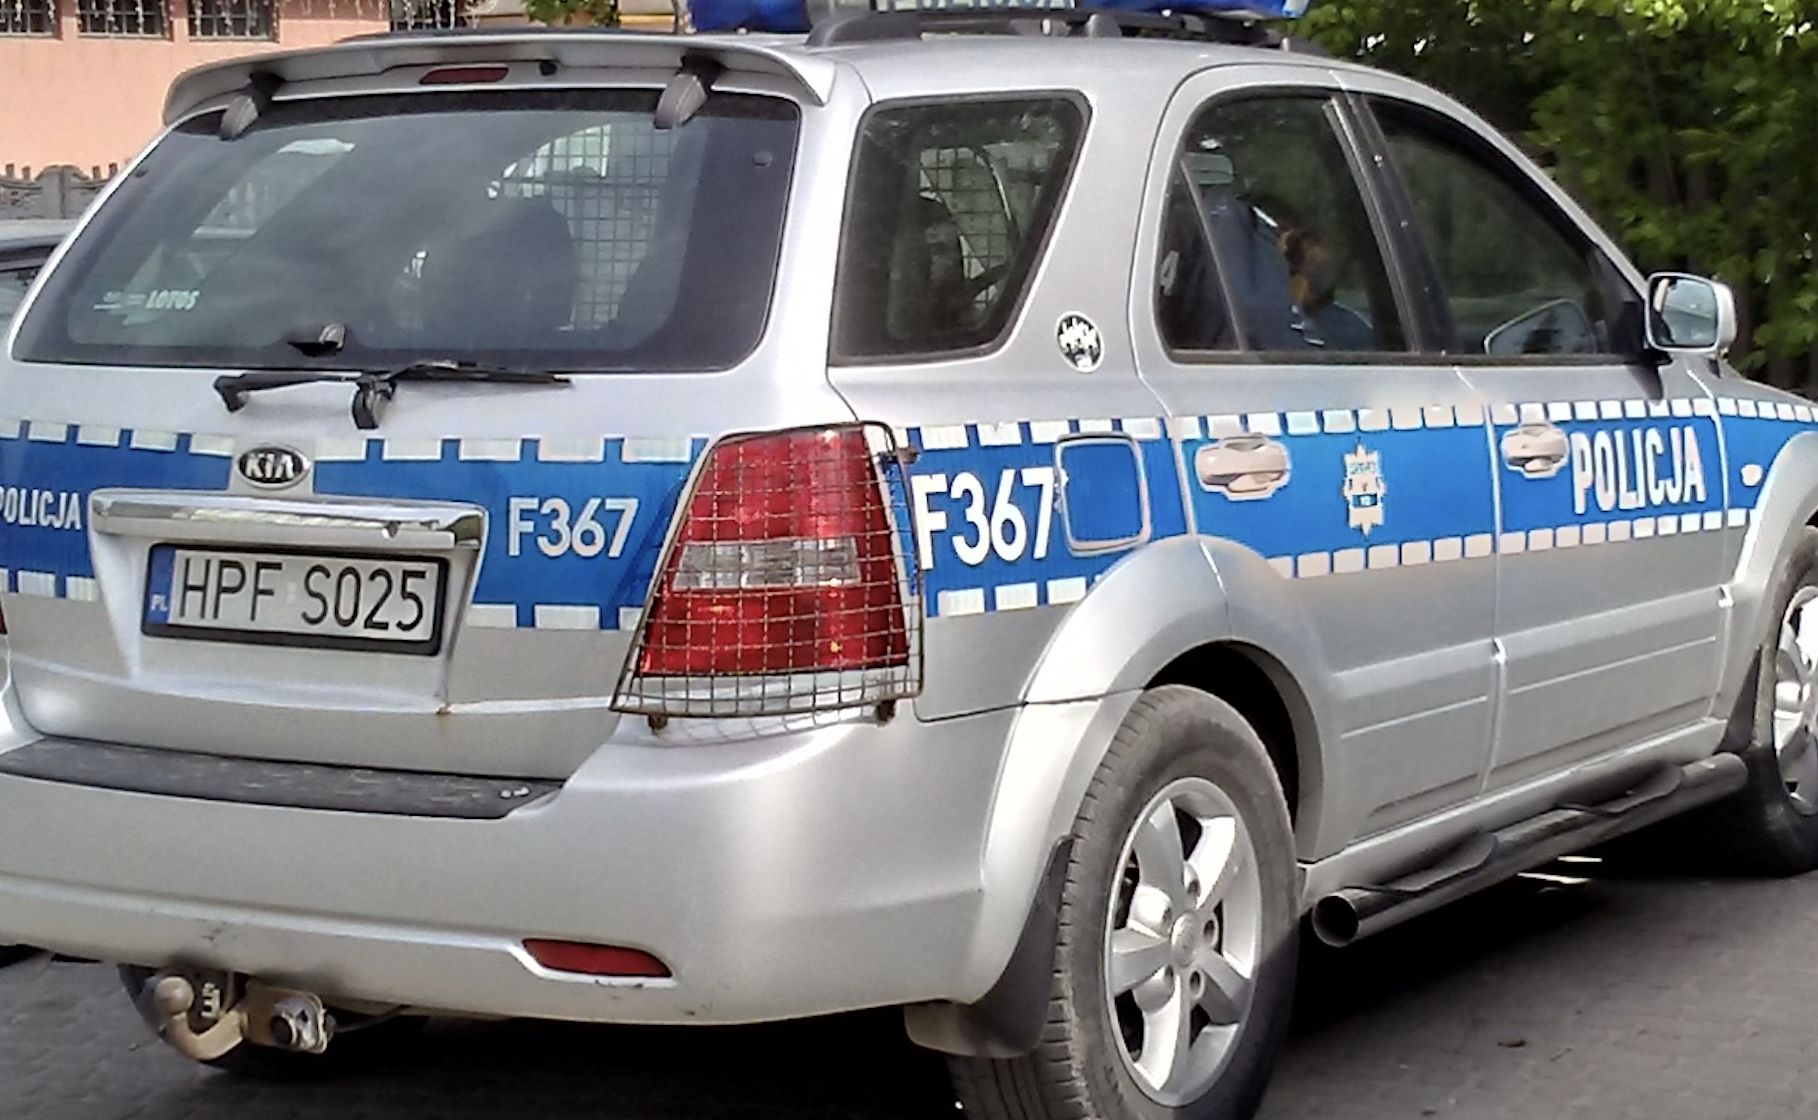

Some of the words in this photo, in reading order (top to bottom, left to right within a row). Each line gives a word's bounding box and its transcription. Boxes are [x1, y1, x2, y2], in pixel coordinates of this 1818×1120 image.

[245, 453, 295, 479] KIA
[1570, 426, 1706, 515] POLICJA
[508, 497, 639, 557] F367
[911, 466, 1055, 570] F367
[150, 595, 168, 612] PL
[179, 558, 283, 622] HPF
[301, 564, 427, 631] S025
